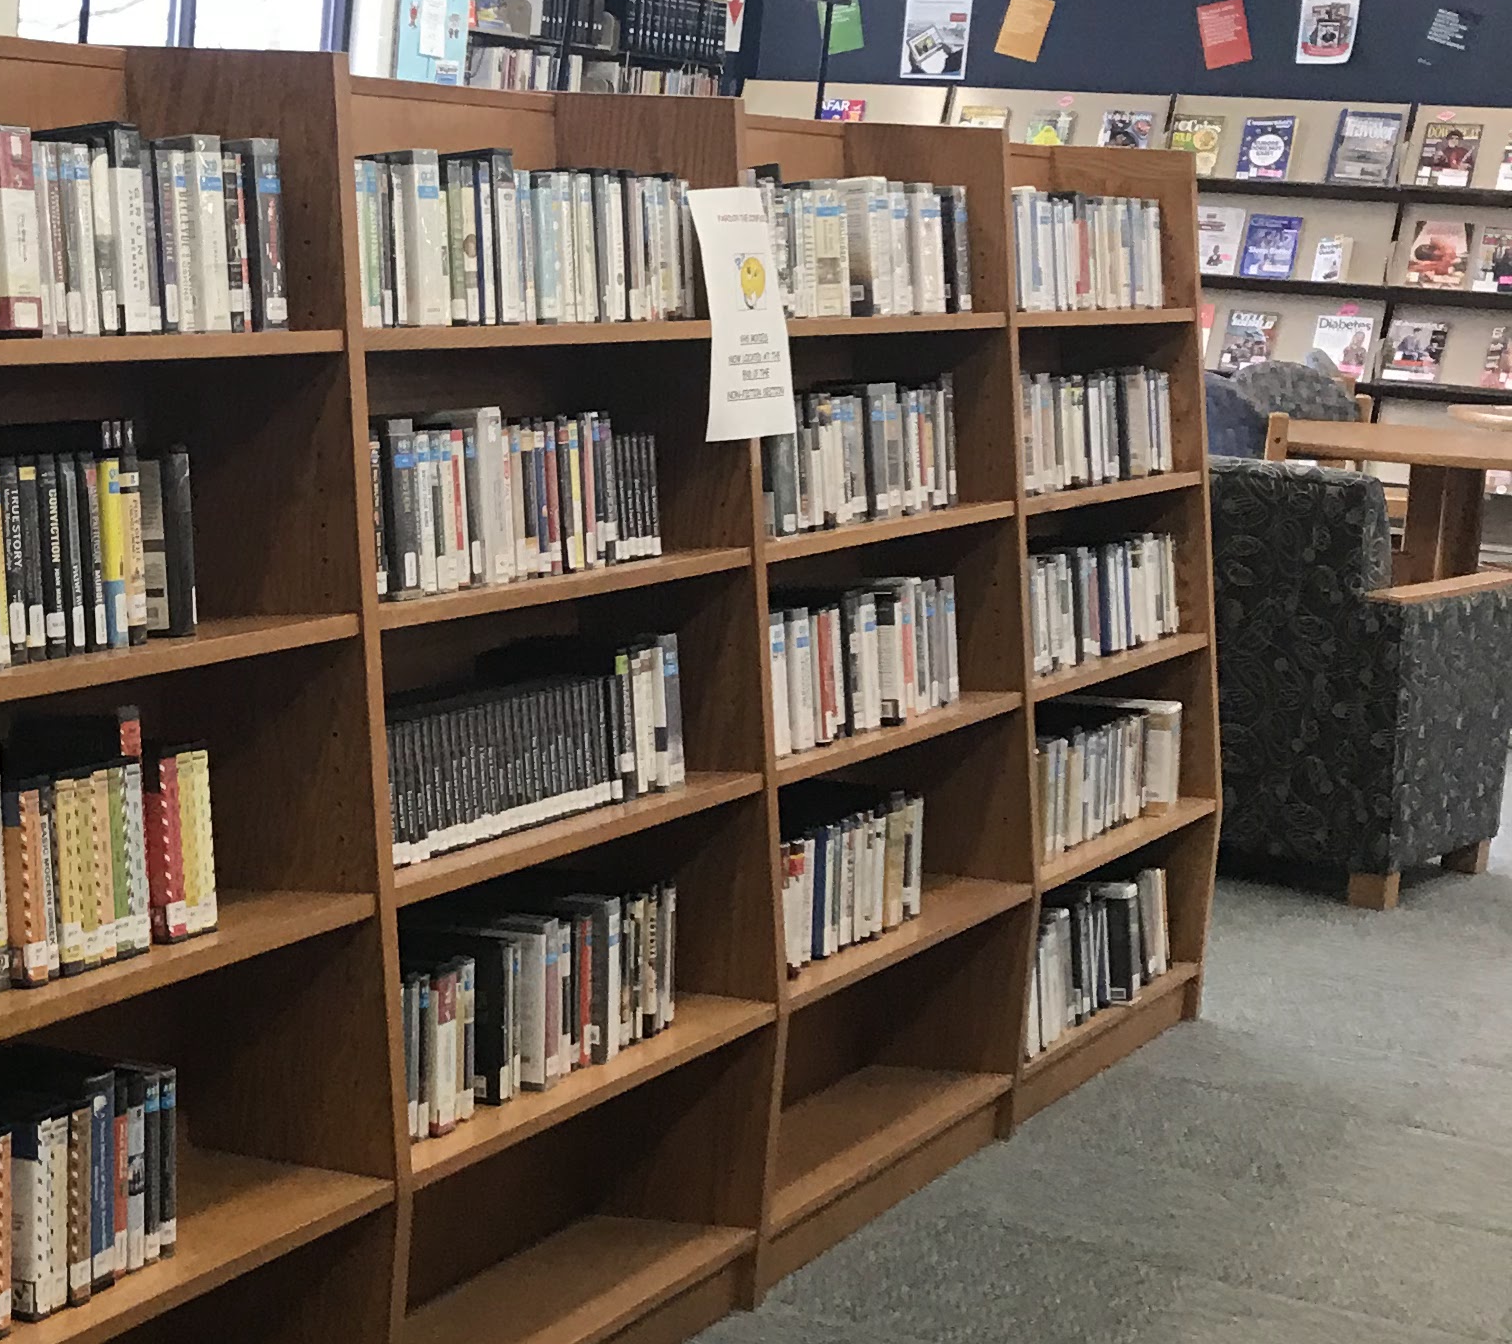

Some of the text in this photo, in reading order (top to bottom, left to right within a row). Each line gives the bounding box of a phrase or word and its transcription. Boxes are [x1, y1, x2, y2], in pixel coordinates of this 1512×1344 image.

[11, 489, 23, 568] TRUE STORY
[48, 488, 61, 563] CONVICTION
